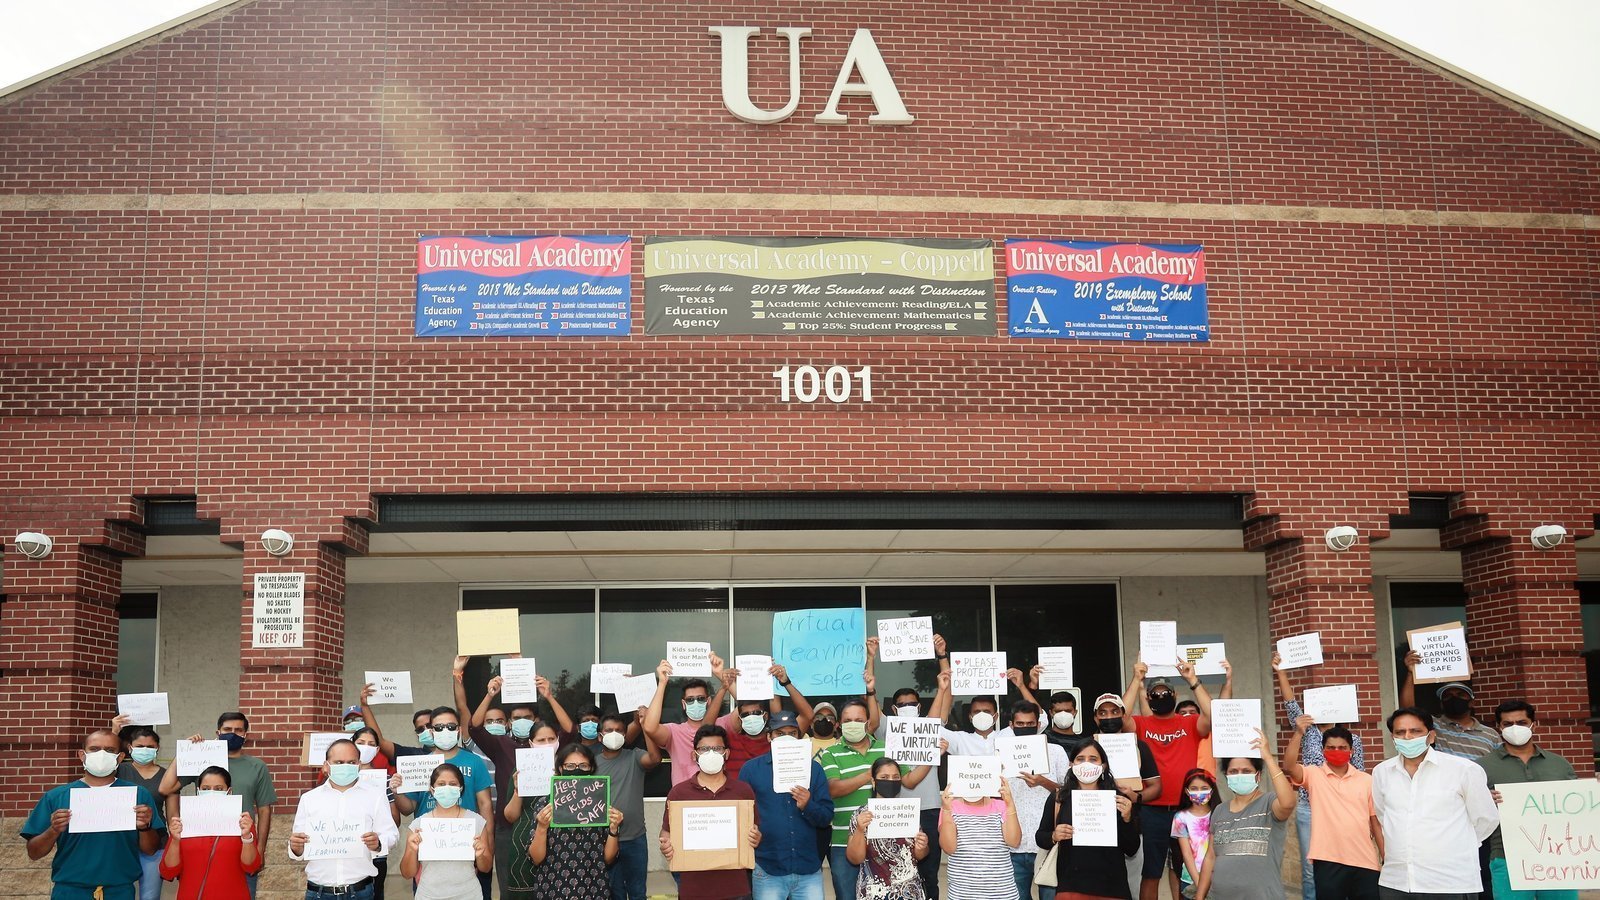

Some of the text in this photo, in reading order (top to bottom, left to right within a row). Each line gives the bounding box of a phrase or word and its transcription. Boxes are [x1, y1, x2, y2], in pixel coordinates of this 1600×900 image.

[708, 26, 914, 124] UA
[424, 242, 625, 272] Universal Academy
[654, 247, 985, 276] Universal Academy Coppell
[1011, 247, 1198, 281] Universal Academy
[449, 284, 456, 293] by
[477, 282, 623, 297] 2018 Met Standard with Distinction
[659, 284, 734, 294] Honored by the
[750, 284, 986, 297] 2013 Met Standard with Distinction
[1012, 284, 1057, 296] Overall Rating
[432, 295, 455, 303] Texas
[677, 295, 715, 304] Texas
[1074, 282, 1192, 307] 2019 Exemplary School
[424, 306, 463, 315] Education
[664, 306, 728, 315] Education
[766, 300, 972, 310] Academic Achievement: Reading/ELA
[1024, 297, 1049, 324] A
[1111, 303, 1159, 313] with Distinction
[767, 311, 971, 320] Academic Achievement: Mathematics
[428, 318, 457, 329] Agency
[672, 318, 720, 329] Agency
[798, 322, 942, 333] Top 25%: Student Progress
[773, 365, 871, 402] 1001
[780, 610, 855, 631] Virtual
[895, 620, 931, 630] VIRTUAL
[282, 633, 297, 643] OFF
[884, 634, 928, 645] AND SAVE
[781, 638, 865, 665] learning
[1421, 642, 1456, 650] VIRTUAL
[885, 647, 928, 657] OUR KIDS
[964, 657, 997, 667] PLEASE
[1419, 657, 1440, 665] KEEP
[956, 667, 999, 678] PROTECT
[1431, 664, 1452, 672] SAFE
[810, 663, 854, 688] safe
[953, 679, 1000, 689] OUR KIDS
[890, 722, 941, 734] WE WANT
[1145, 729, 1188, 742] NAUTICA
[902, 736, 941, 749] VIRTUAL
[891, 750, 933, 762] LEARNING
[554, 779, 578, 797] HELP
[554, 781, 604, 810] KEEP OUR
[569, 797, 593, 813] KIDS
[577, 800, 606, 824] SAFE
[310, 820, 361, 832] WE WANT
[429, 822, 472, 834] WE LOVE
[435, 840, 447, 849] UA
